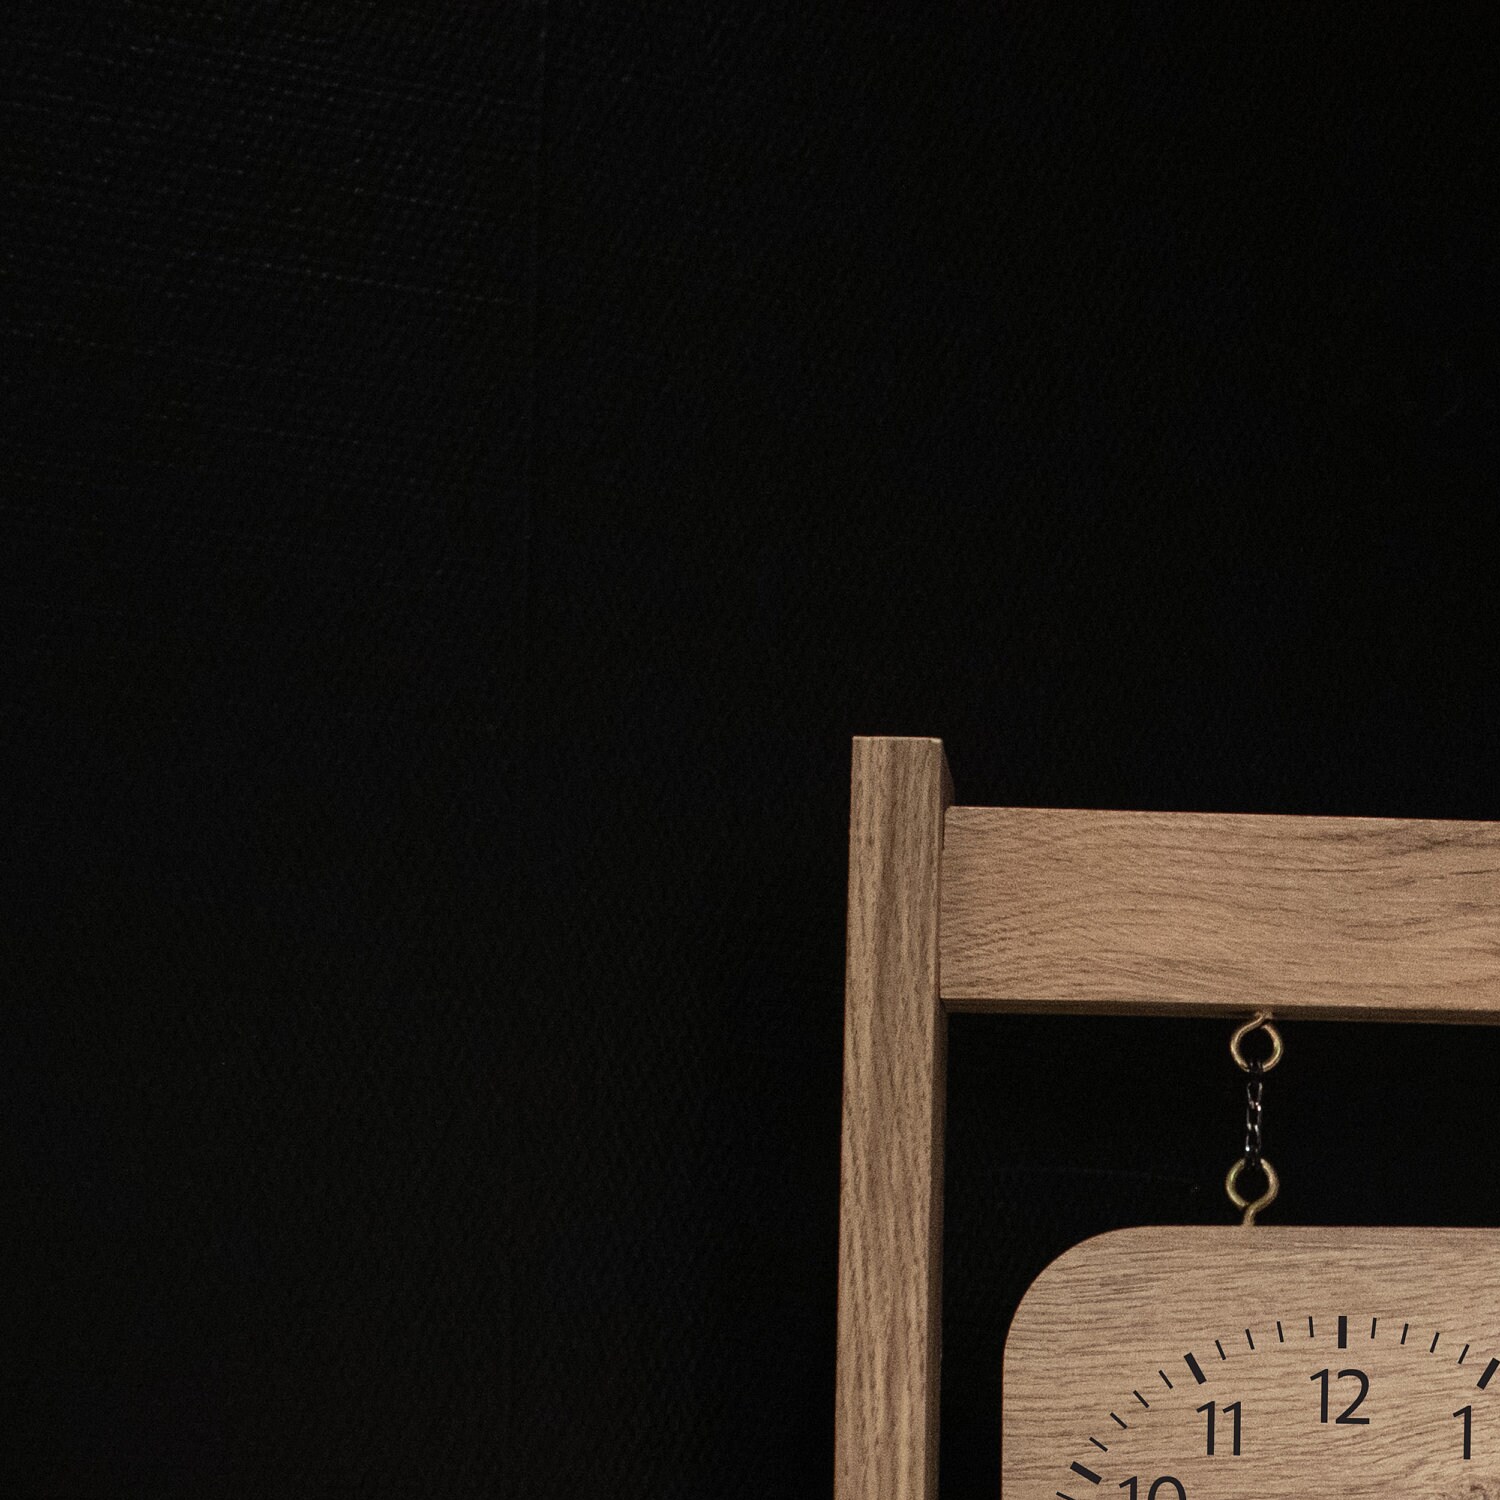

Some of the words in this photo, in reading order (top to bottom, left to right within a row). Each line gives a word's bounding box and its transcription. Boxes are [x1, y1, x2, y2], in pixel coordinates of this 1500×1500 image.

[1309, 1368, 1371, 1425] 12
[1196, 1400, 1242, 1456] 11
[1452, 1405, 1472, 1459] 1
